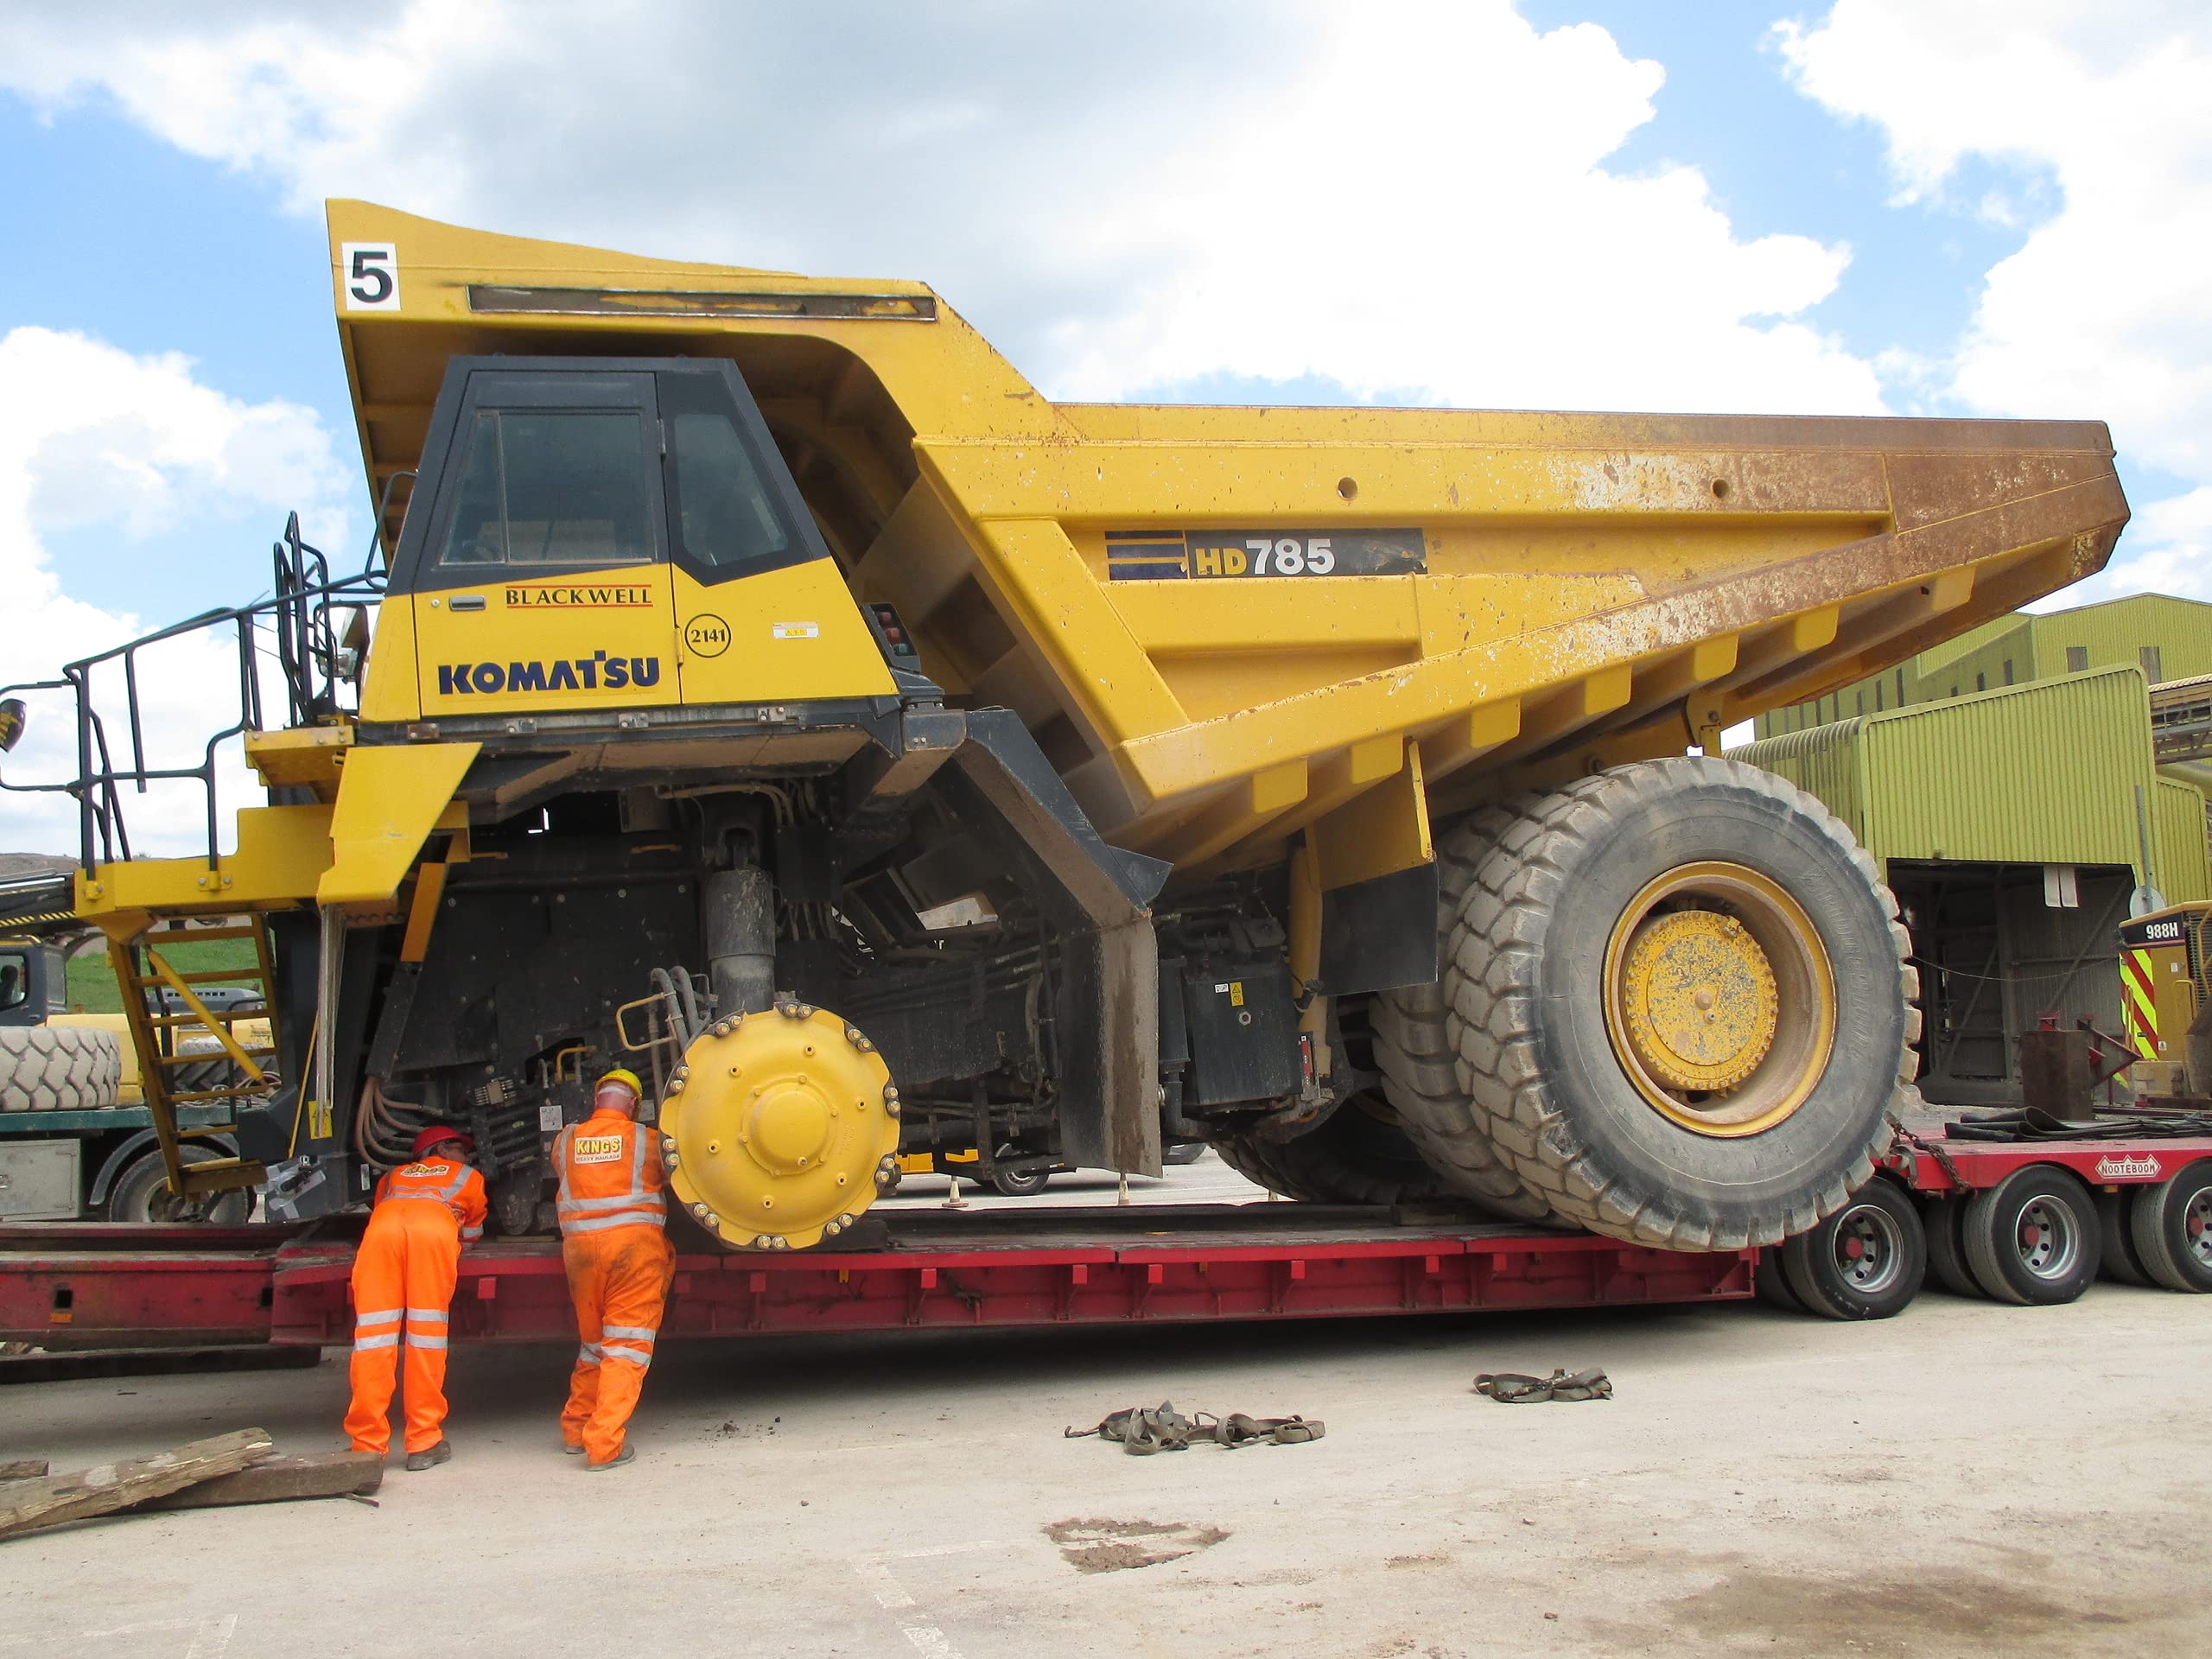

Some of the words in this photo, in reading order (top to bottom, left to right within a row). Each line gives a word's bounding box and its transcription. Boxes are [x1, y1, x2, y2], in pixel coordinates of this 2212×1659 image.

[350, 251, 393, 303] 5
[1195, 538, 1336, 575] HD785
[505, 587, 653, 606] BLACKWELL
[690, 628, 726, 644] 2141
[438, 650, 660, 696] KOMATSU
[2145, 921, 2178, 939] 988H
[576, 1138, 620, 1155] KINGS
[2101, 1163, 2156, 1174] NOOTEBOOM
